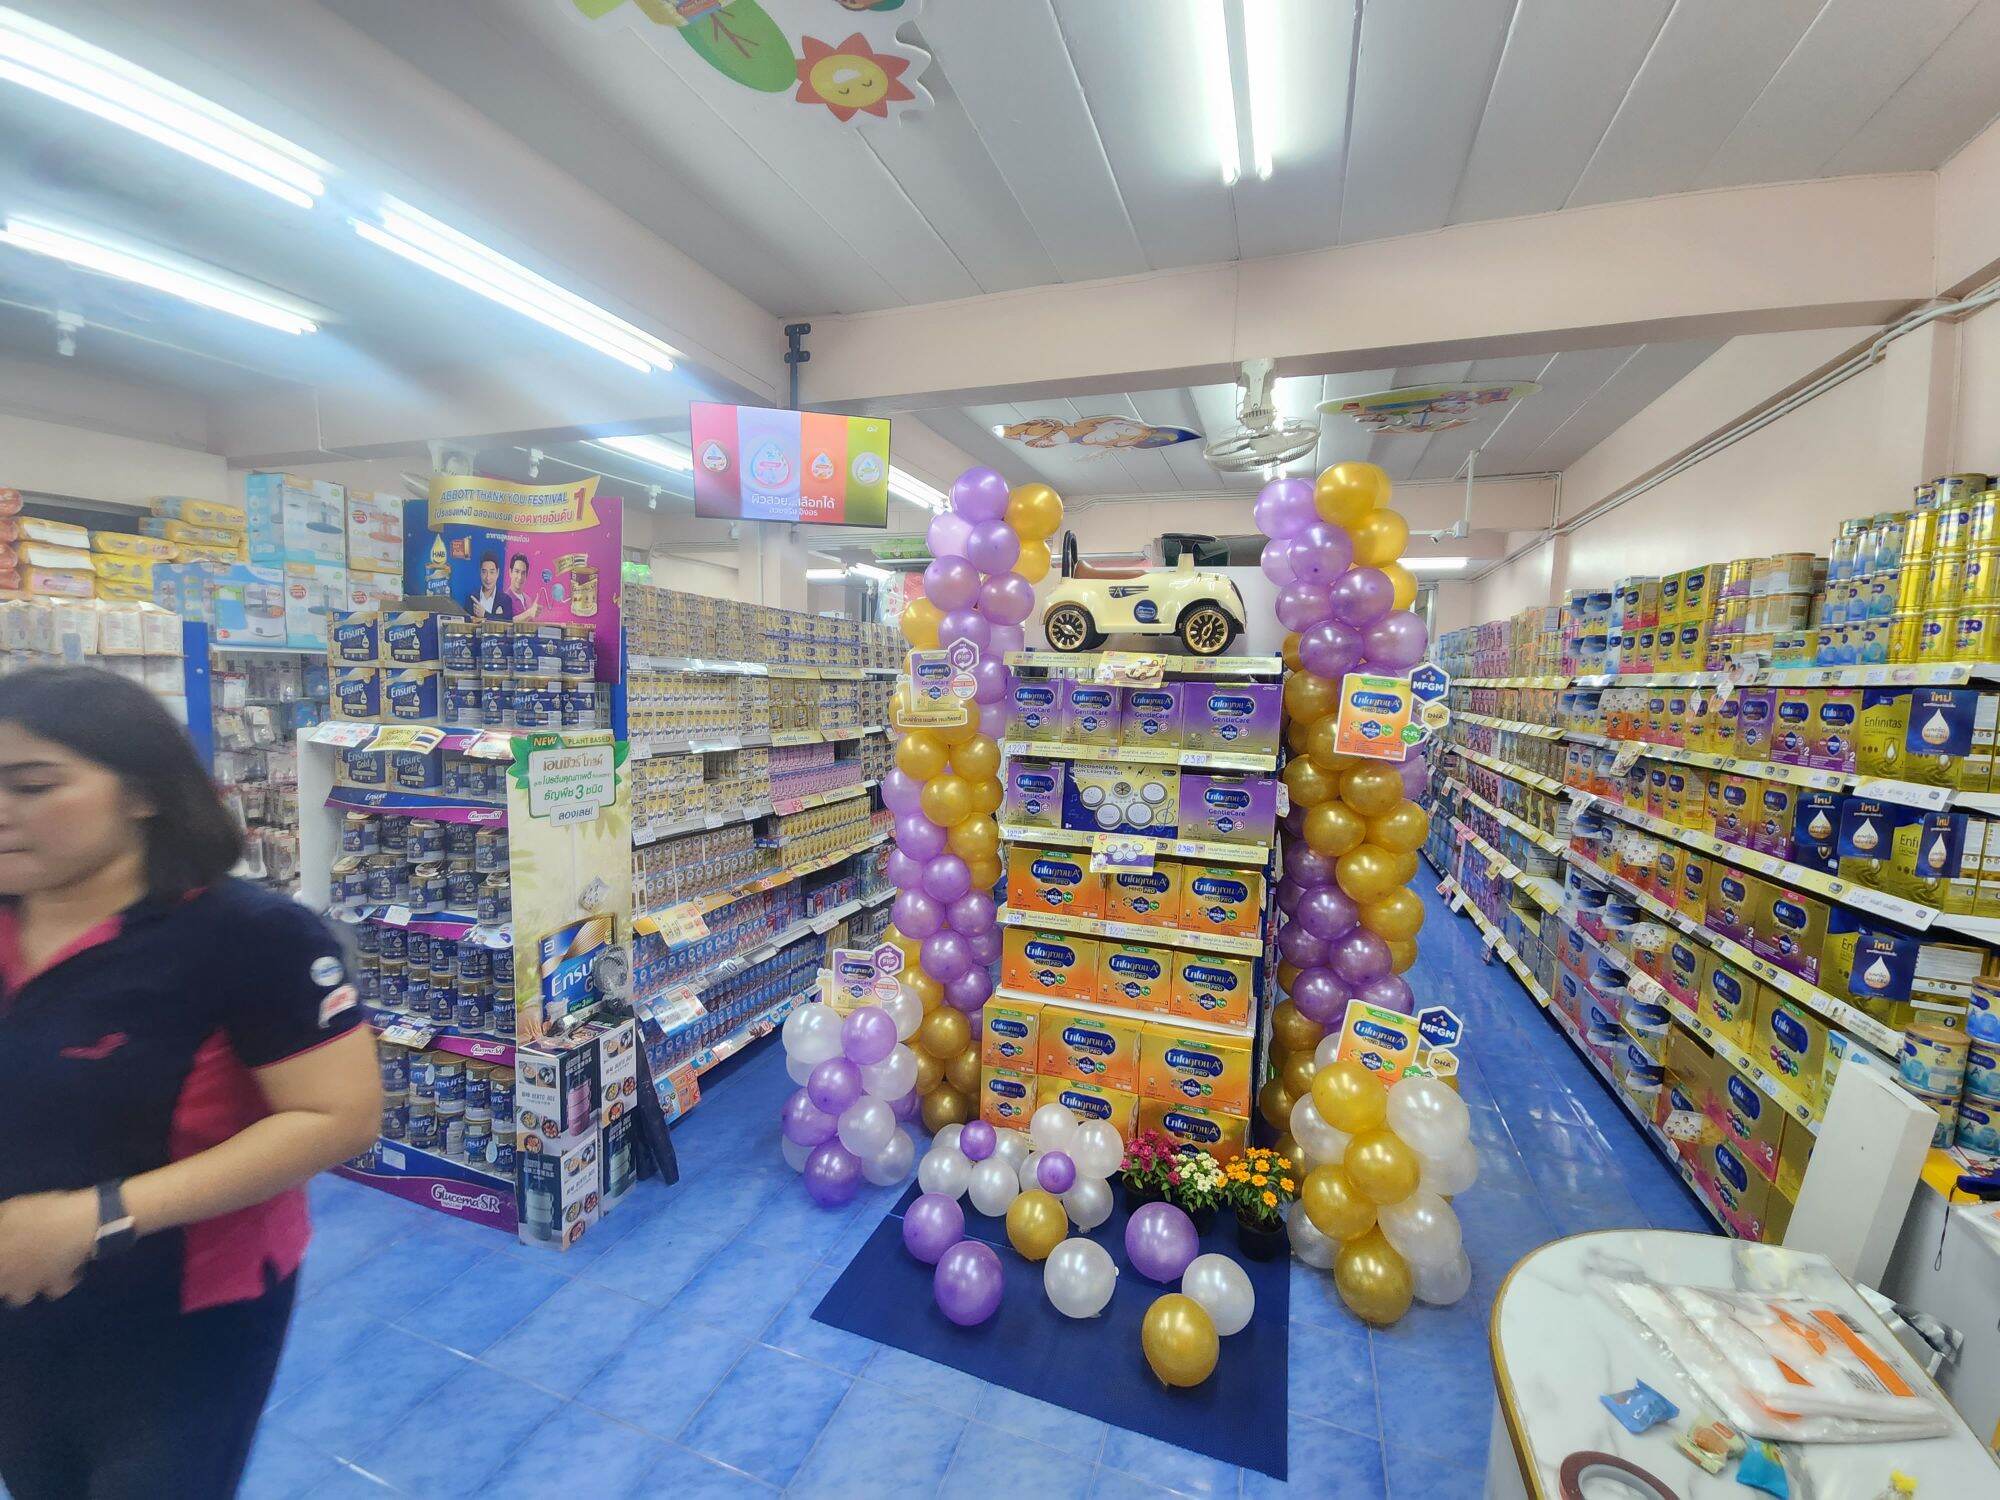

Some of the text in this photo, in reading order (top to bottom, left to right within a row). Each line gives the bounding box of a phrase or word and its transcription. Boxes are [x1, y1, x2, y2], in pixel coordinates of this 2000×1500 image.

[441, 489, 568, 508] ABBOTT THANK YOU FESTIVAL
[573, 487, 587, 520] 1
[514, 508, 574, 524] ยอดขายอันดับ
[339, 627, 366, 640] Ensure
[389, 628, 416, 642] Ensure
[340, 683, 364, 696] Ensure
[391, 684, 416, 698] Ensure
[1412, 681, 1444, 692] MFGM
[1864, 717, 1902, 728] Enfinitas
[534, 736, 558, 746] NEW
[1804, 746, 1810, 756] 2
[1850, 752, 1856, 762] 2
[396, 754, 422, 766] Ensure
[544, 784, 603, 802] ธัญพืช 3 ชนิด
[559, 807, 592, 820] ลองเลย!
[1782, 838, 1786, 847] 1
[1033, 864, 1069, 878] Enfagrow
[1194, 881, 1235, 894] Enfagrow
[1748, 926, 1754, 938] 2
[1027, 946, 1064, 959] Enfagrow
[1111, 958, 1150, 972] Enfagrow
[1812, 958, 1816, 969] 1
[552, 955, 598, 998] Ensu
[1185, 968, 1225, 983] Enfagrow
[1421, 1022, 1456, 1040] MFGM
[1064, 1032, 1103, 1046] Enfagrow
[1167, 1053, 1210, 1068] Enfagrow
[1434, 1058, 1452, 1068] DHA
[1061, 1094, 1100, 1110] Enfagrow
[1166, 1118, 1208, 1132] Enfagrow
[431, 1184, 500, 1214] GlucernaSR
